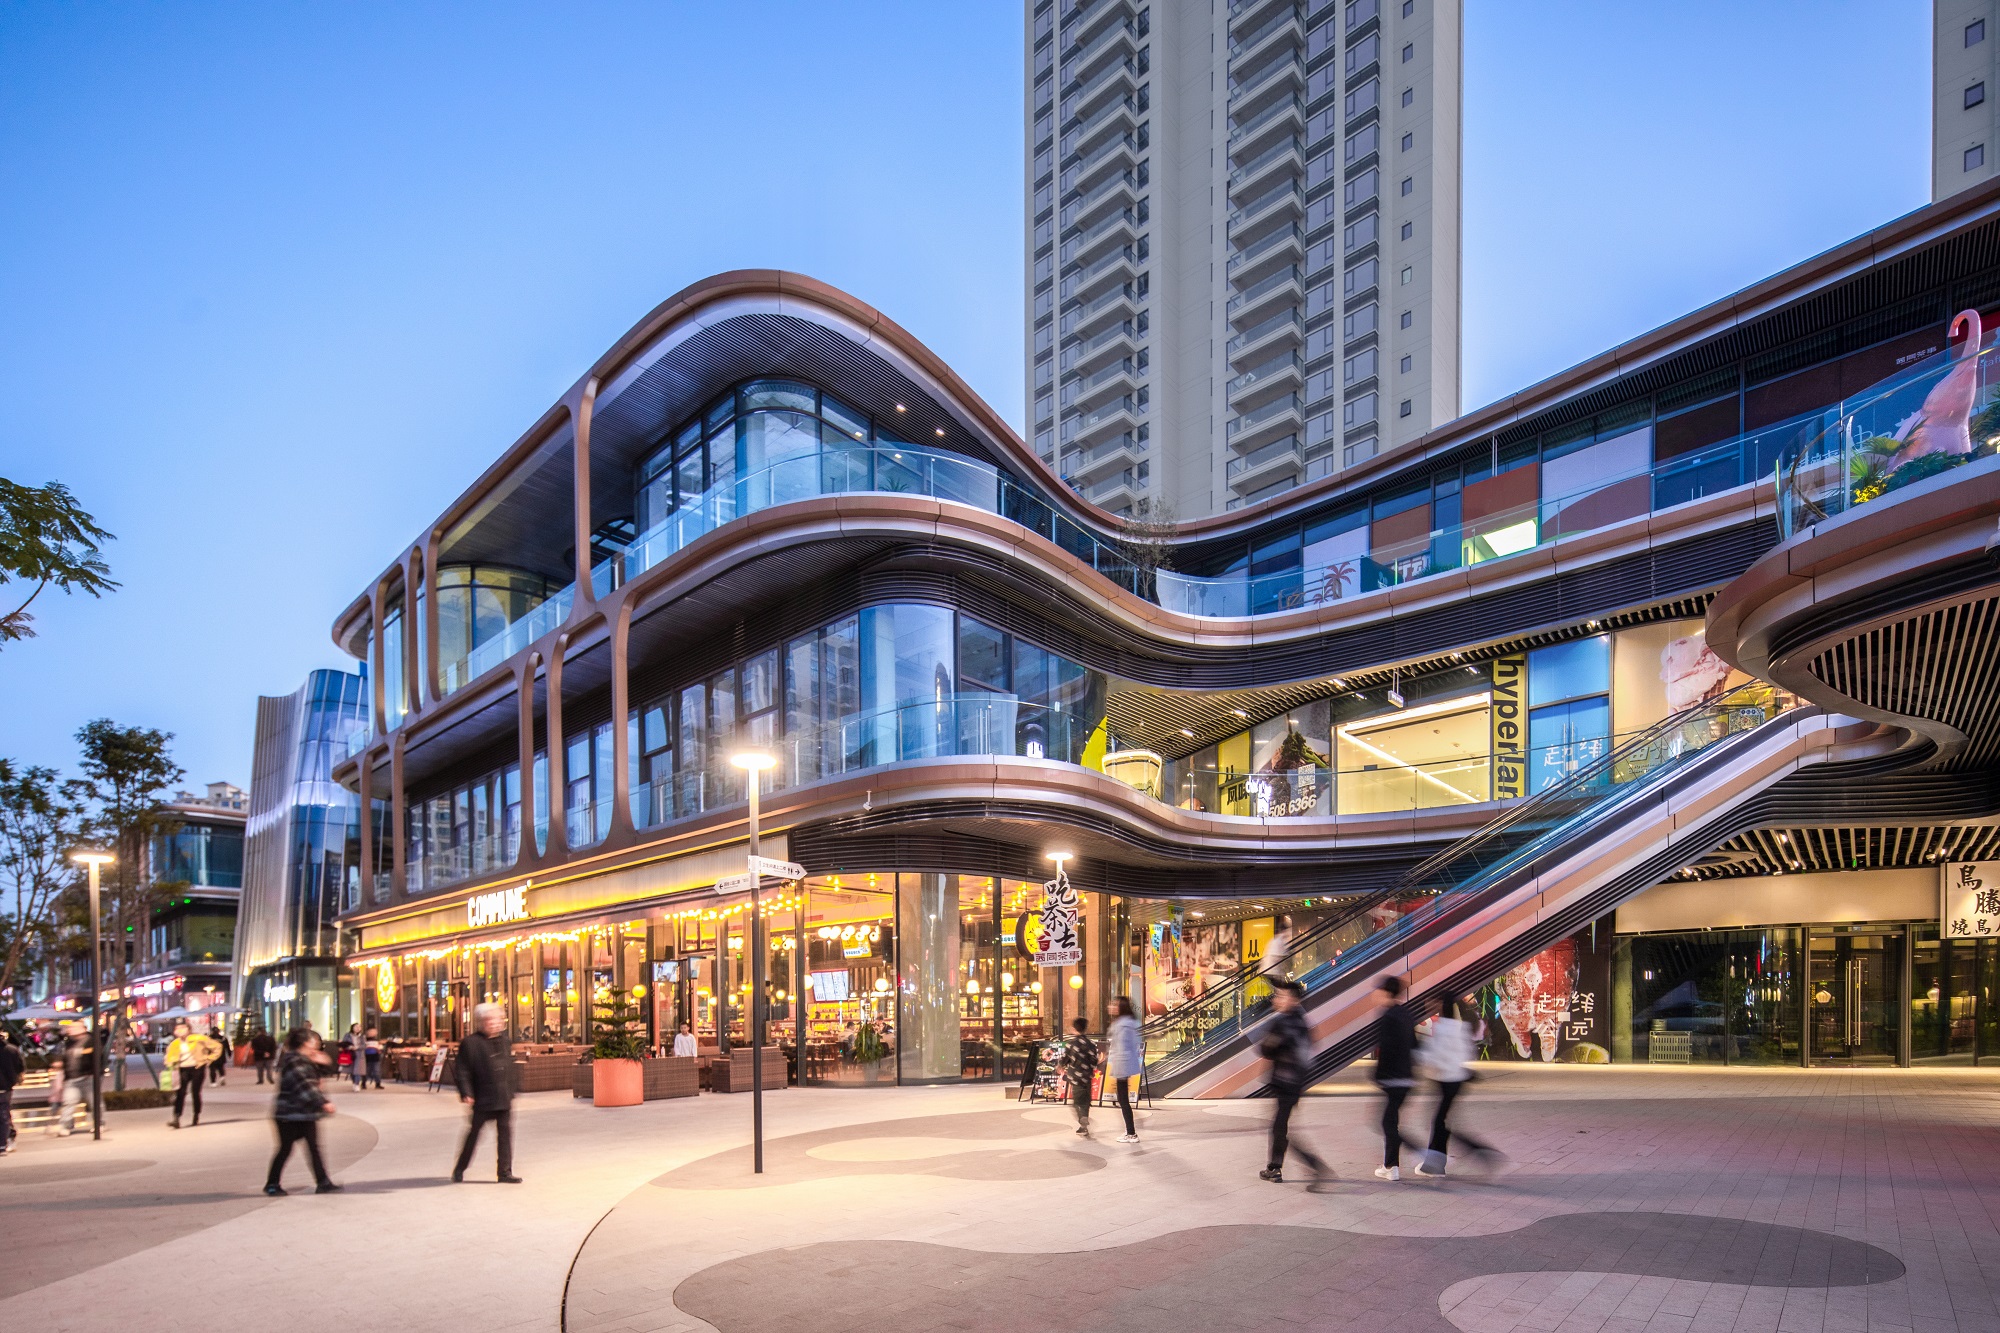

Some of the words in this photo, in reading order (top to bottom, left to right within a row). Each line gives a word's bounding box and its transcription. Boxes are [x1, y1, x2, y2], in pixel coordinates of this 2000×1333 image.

[1289, 795, 1317, 814] 6366
[468, 885, 529, 928] COMMUNE
[1951, 918, 2000, 936] 燒鳥
